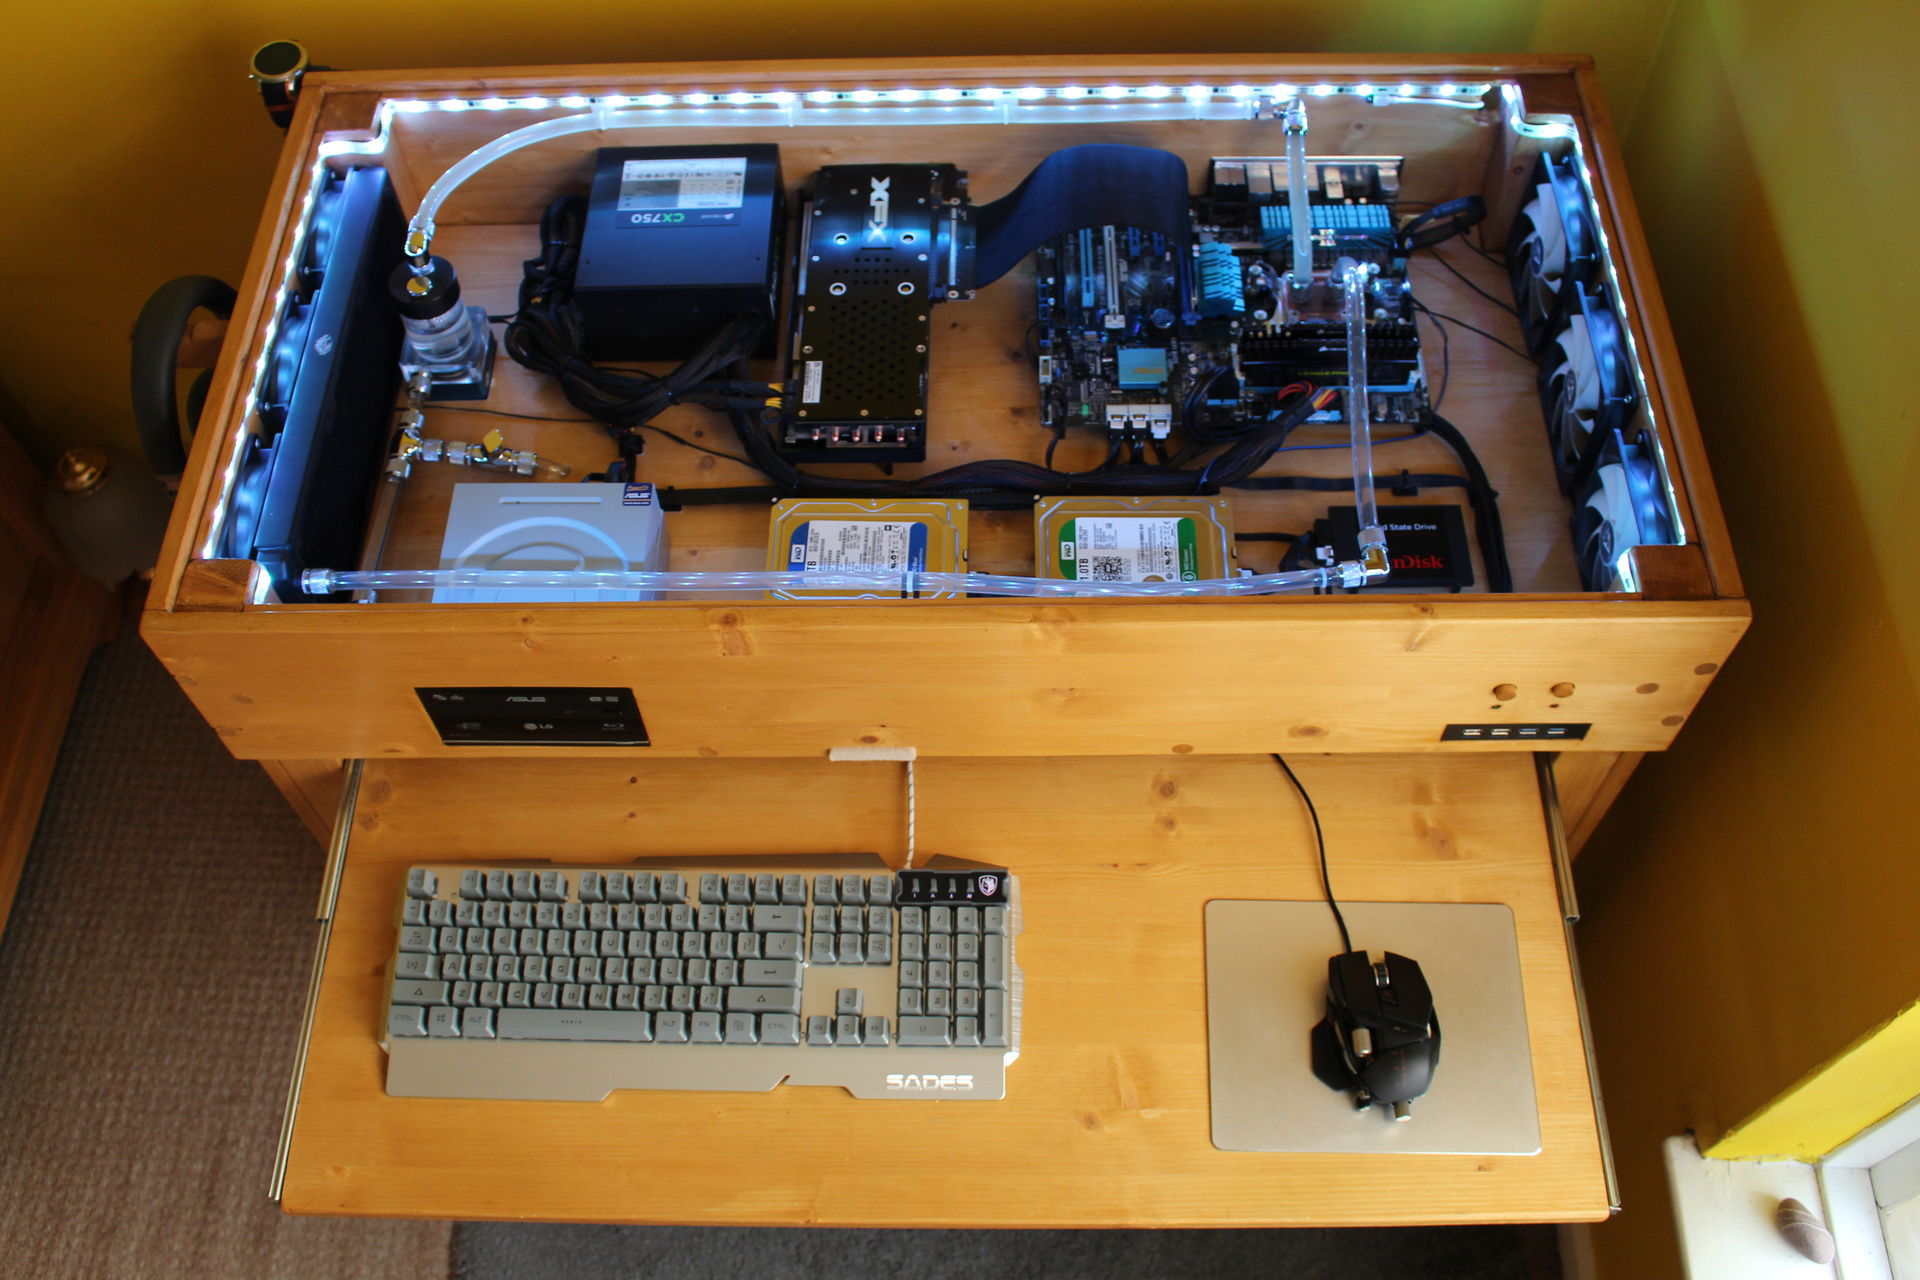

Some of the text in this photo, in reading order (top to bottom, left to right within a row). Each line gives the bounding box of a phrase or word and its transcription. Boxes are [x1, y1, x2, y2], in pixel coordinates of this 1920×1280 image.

[631, 213, 685, 224] CX750
[867, 176, 890, 242] XFX
[1079, 558, 1088, 580] 1.0TB
[886, 1074, 974, 1091] SADES
